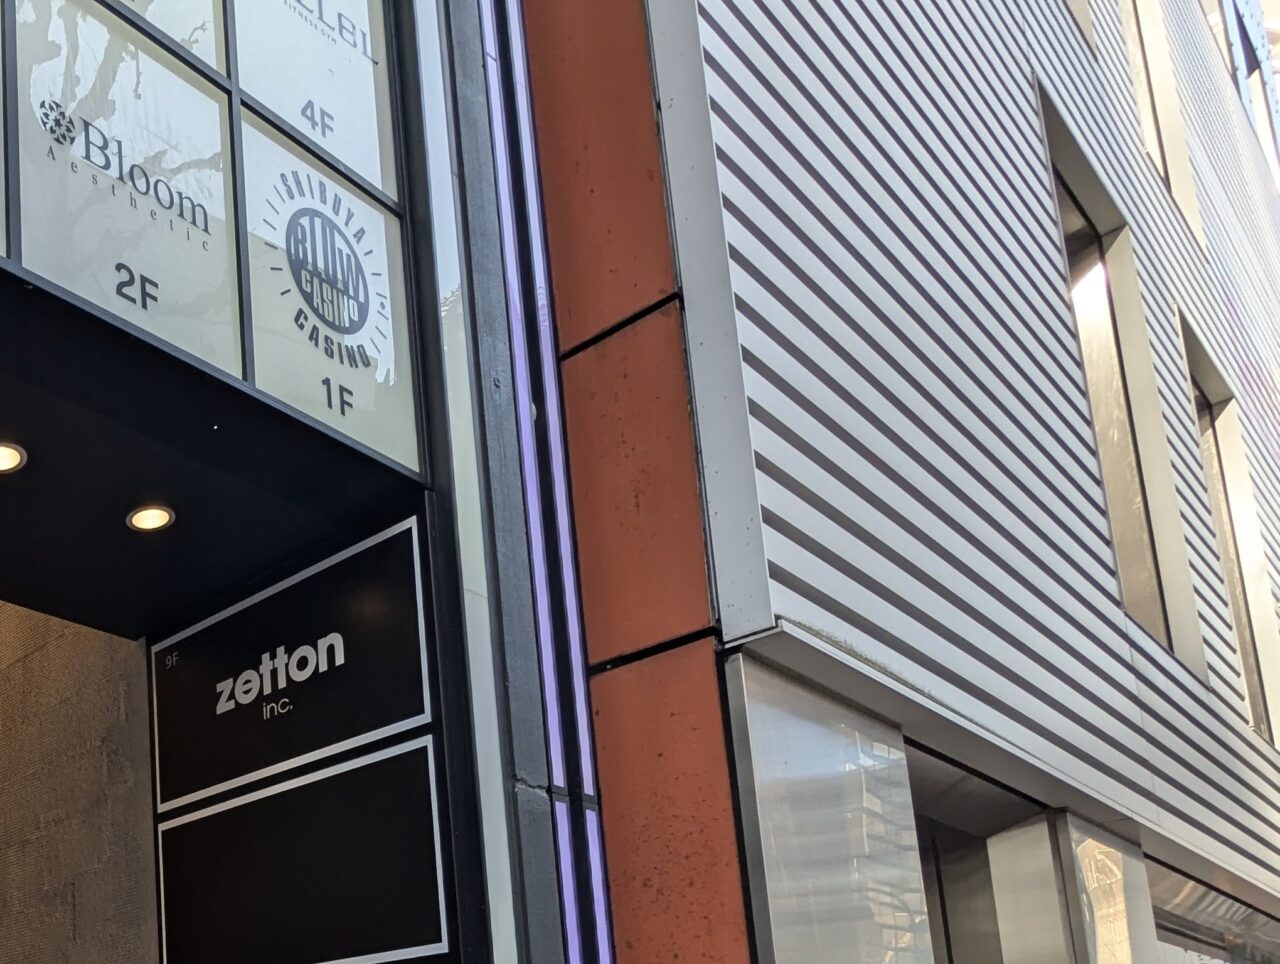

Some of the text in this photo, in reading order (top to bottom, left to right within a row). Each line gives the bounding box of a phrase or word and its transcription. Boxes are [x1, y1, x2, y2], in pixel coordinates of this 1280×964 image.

[301, 99, 335, 138] 4F
[47, 146, 209, 251] Aesthetic
[79, 116, 211, 236] Bloom
[280, 170, 367, 245] SHIBUYA
[115, 262, 159, 311] 2F
[301, 268, 360, 328] CASINO
[293, 307, 371, 369] CASINO
[322, 377, 354, 417] 1F
[165, 652, 179, 669] 9F
[216, 632, 345, 715] zetton
[262, 697, 293, 720] inc.
